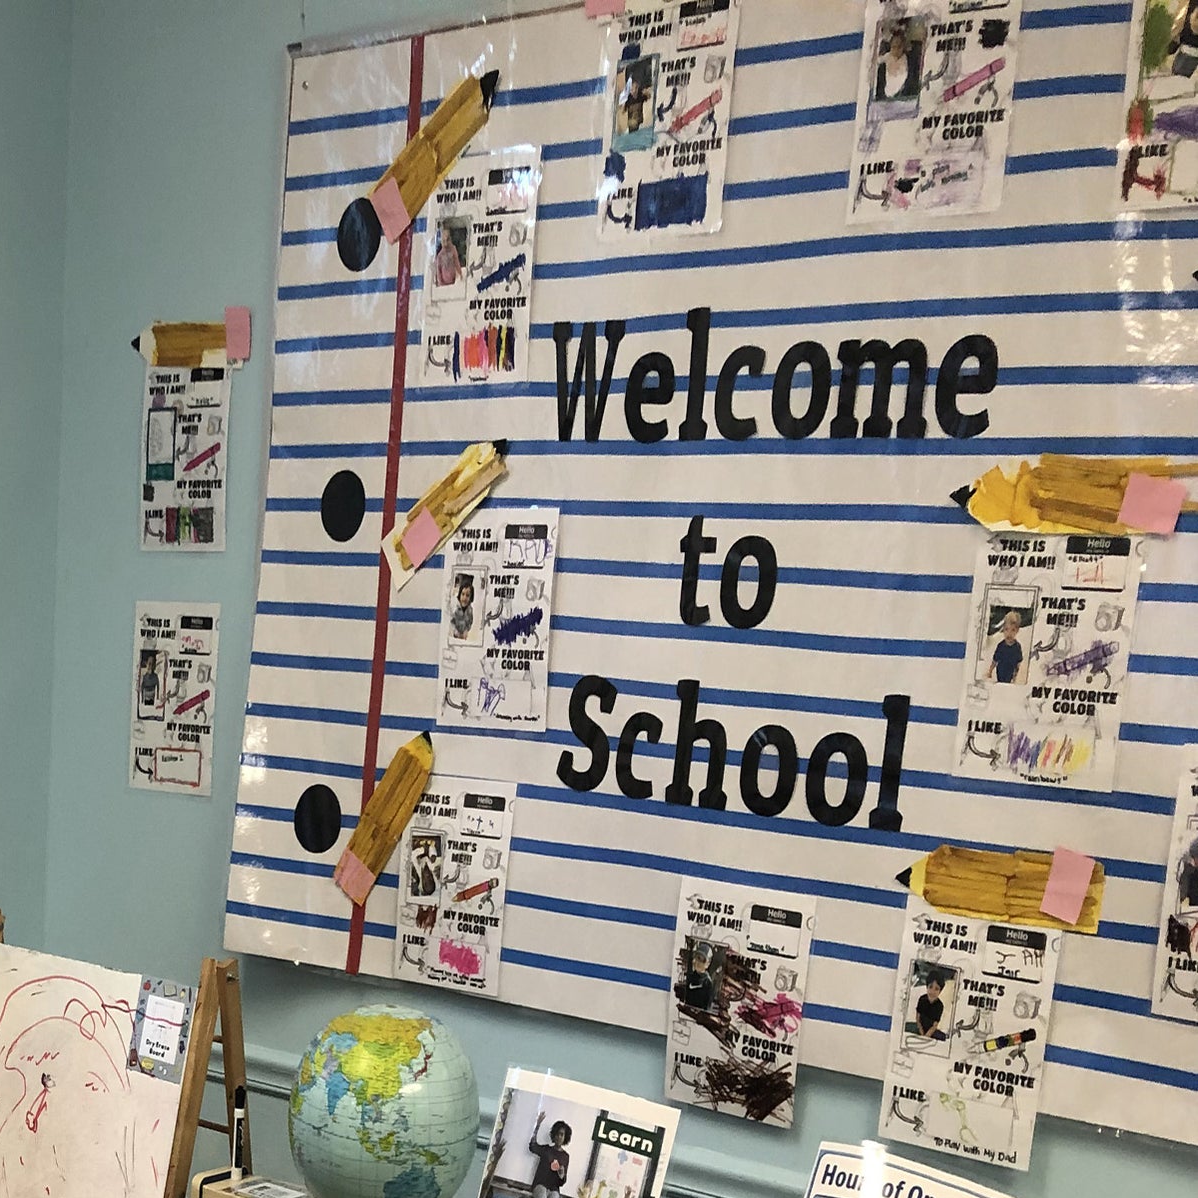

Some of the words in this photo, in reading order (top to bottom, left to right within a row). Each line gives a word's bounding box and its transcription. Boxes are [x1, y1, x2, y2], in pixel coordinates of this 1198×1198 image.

[553, 307, 999, 443] Welcome
[461, 529, 481, 539] THIS
[483, 529, 491, 538] IS
[453, 542, 472, 552] WHO
[1001, 539, 1030, 552] THIS
[1033, 540, 1046, 552] IS
[1087, 539, 1111, 548] Hello
[988, 555, 1016, 568] WHO
[1019, 556, 1024, 567] I
[1026, 556, 1056, 570] AM!!
[680, 515, 778, 629] to
[489, 575, 519, 586] THAT'S
[1041, 597, 1086, 611] THAT'S
[487, 649, 500, 658] MY
[502, 649, 544, 660] FAVORITE
[501, 659, 530, 670] COLOR
[1032, 686, 1051, 699] MY
[1054, 688, 1118, 705] FAVORITE
[1052, 702, 1095, 716] COLOR
[967, 720, 972, 731] I
[974, 722, 1002, 734] LIKE
[556, 674, 911, 832] School
[925, 920, 952, 934] THIS
[955, 924, 968, 936] IS
[1006, 930, 1028, 941] Hello
[913, 932, 942, 947] WHO
[950, 938, 977, 954] AM!!
[963, 979, 1005, 997] THAT'S
[146, 1039, 155, 1048] Dry
[156, 1042, 170, 1051] Erase
[149, 1048, 165, 1058] Board
[954, 1062, 973, 1076] MY
[974, 1066, 1035, 1089] FAVORITE
[900, 1087, 926, 1101] LIKE
[973, 1079, 1015, 1097] COLOR
[598, 1121, 653, 1153] Learn
[984, 1149, 995, 1161] My
[998, 1151, 1017, 1164] Dad
